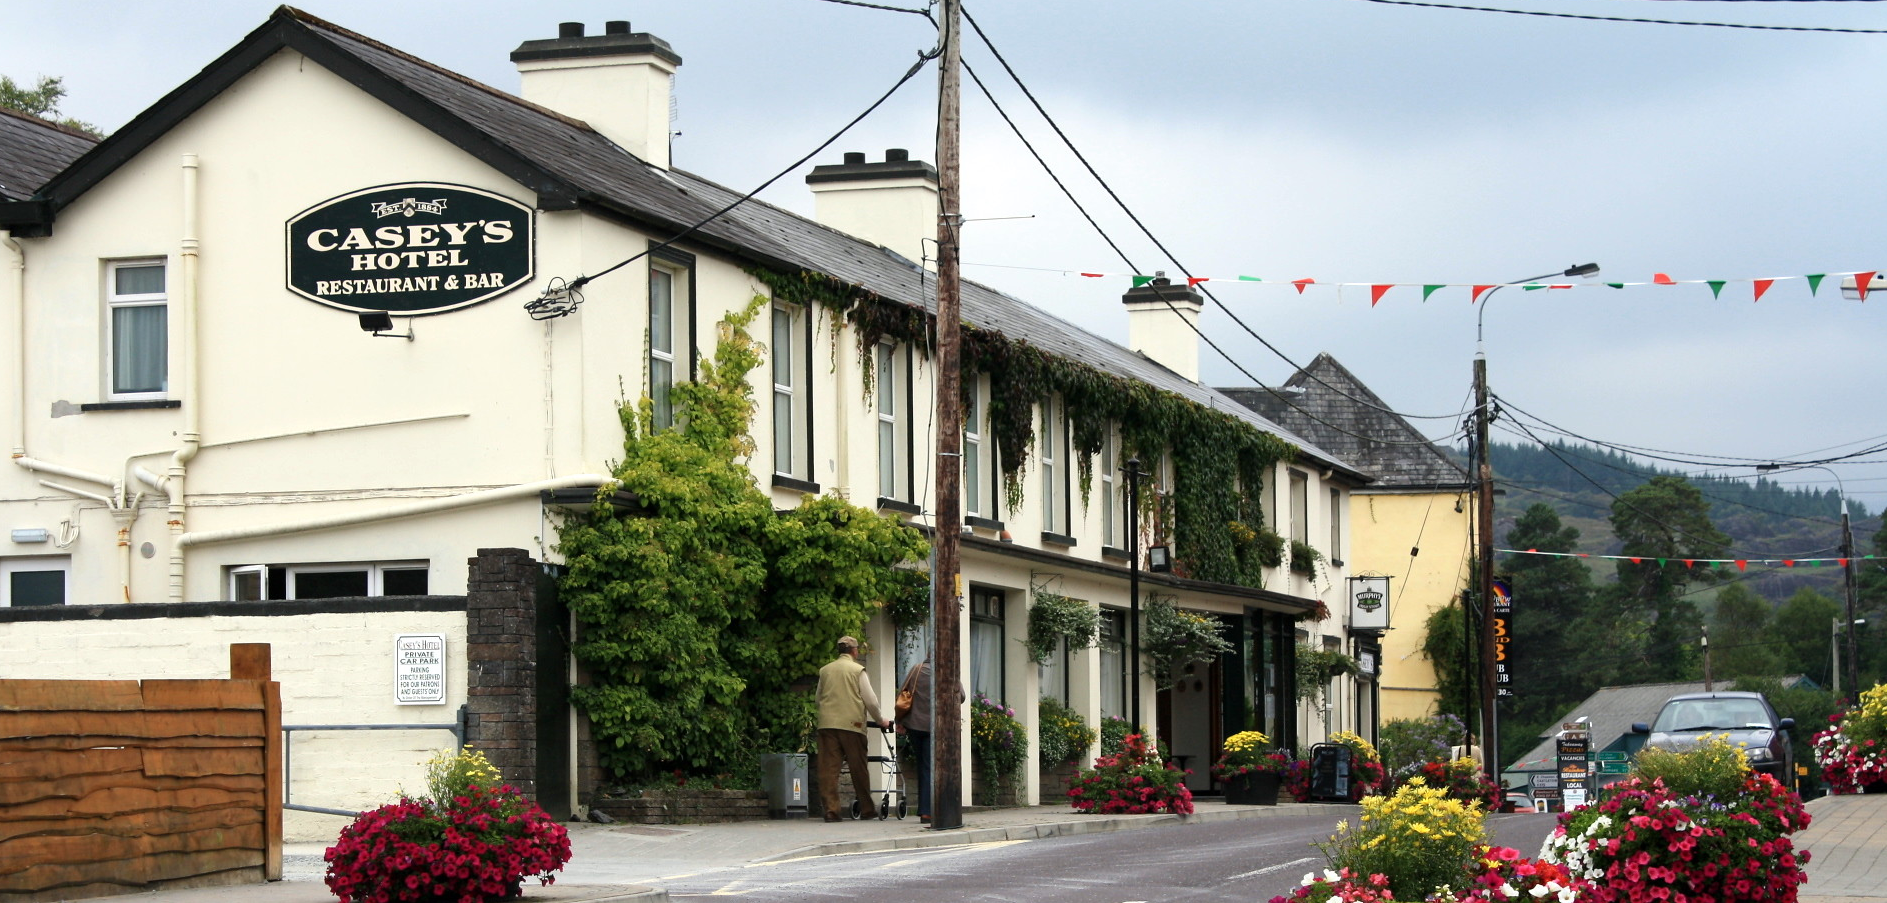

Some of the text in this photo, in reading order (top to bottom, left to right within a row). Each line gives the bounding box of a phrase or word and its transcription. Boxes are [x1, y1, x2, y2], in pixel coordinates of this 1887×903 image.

[381, 205, 402, 214] EST.
[306, 220, 514, 252] CASEY'S
[351, 250, 469, 271] HOTEL
[316, 272, 504, 296] RESTAURANT & BAR
